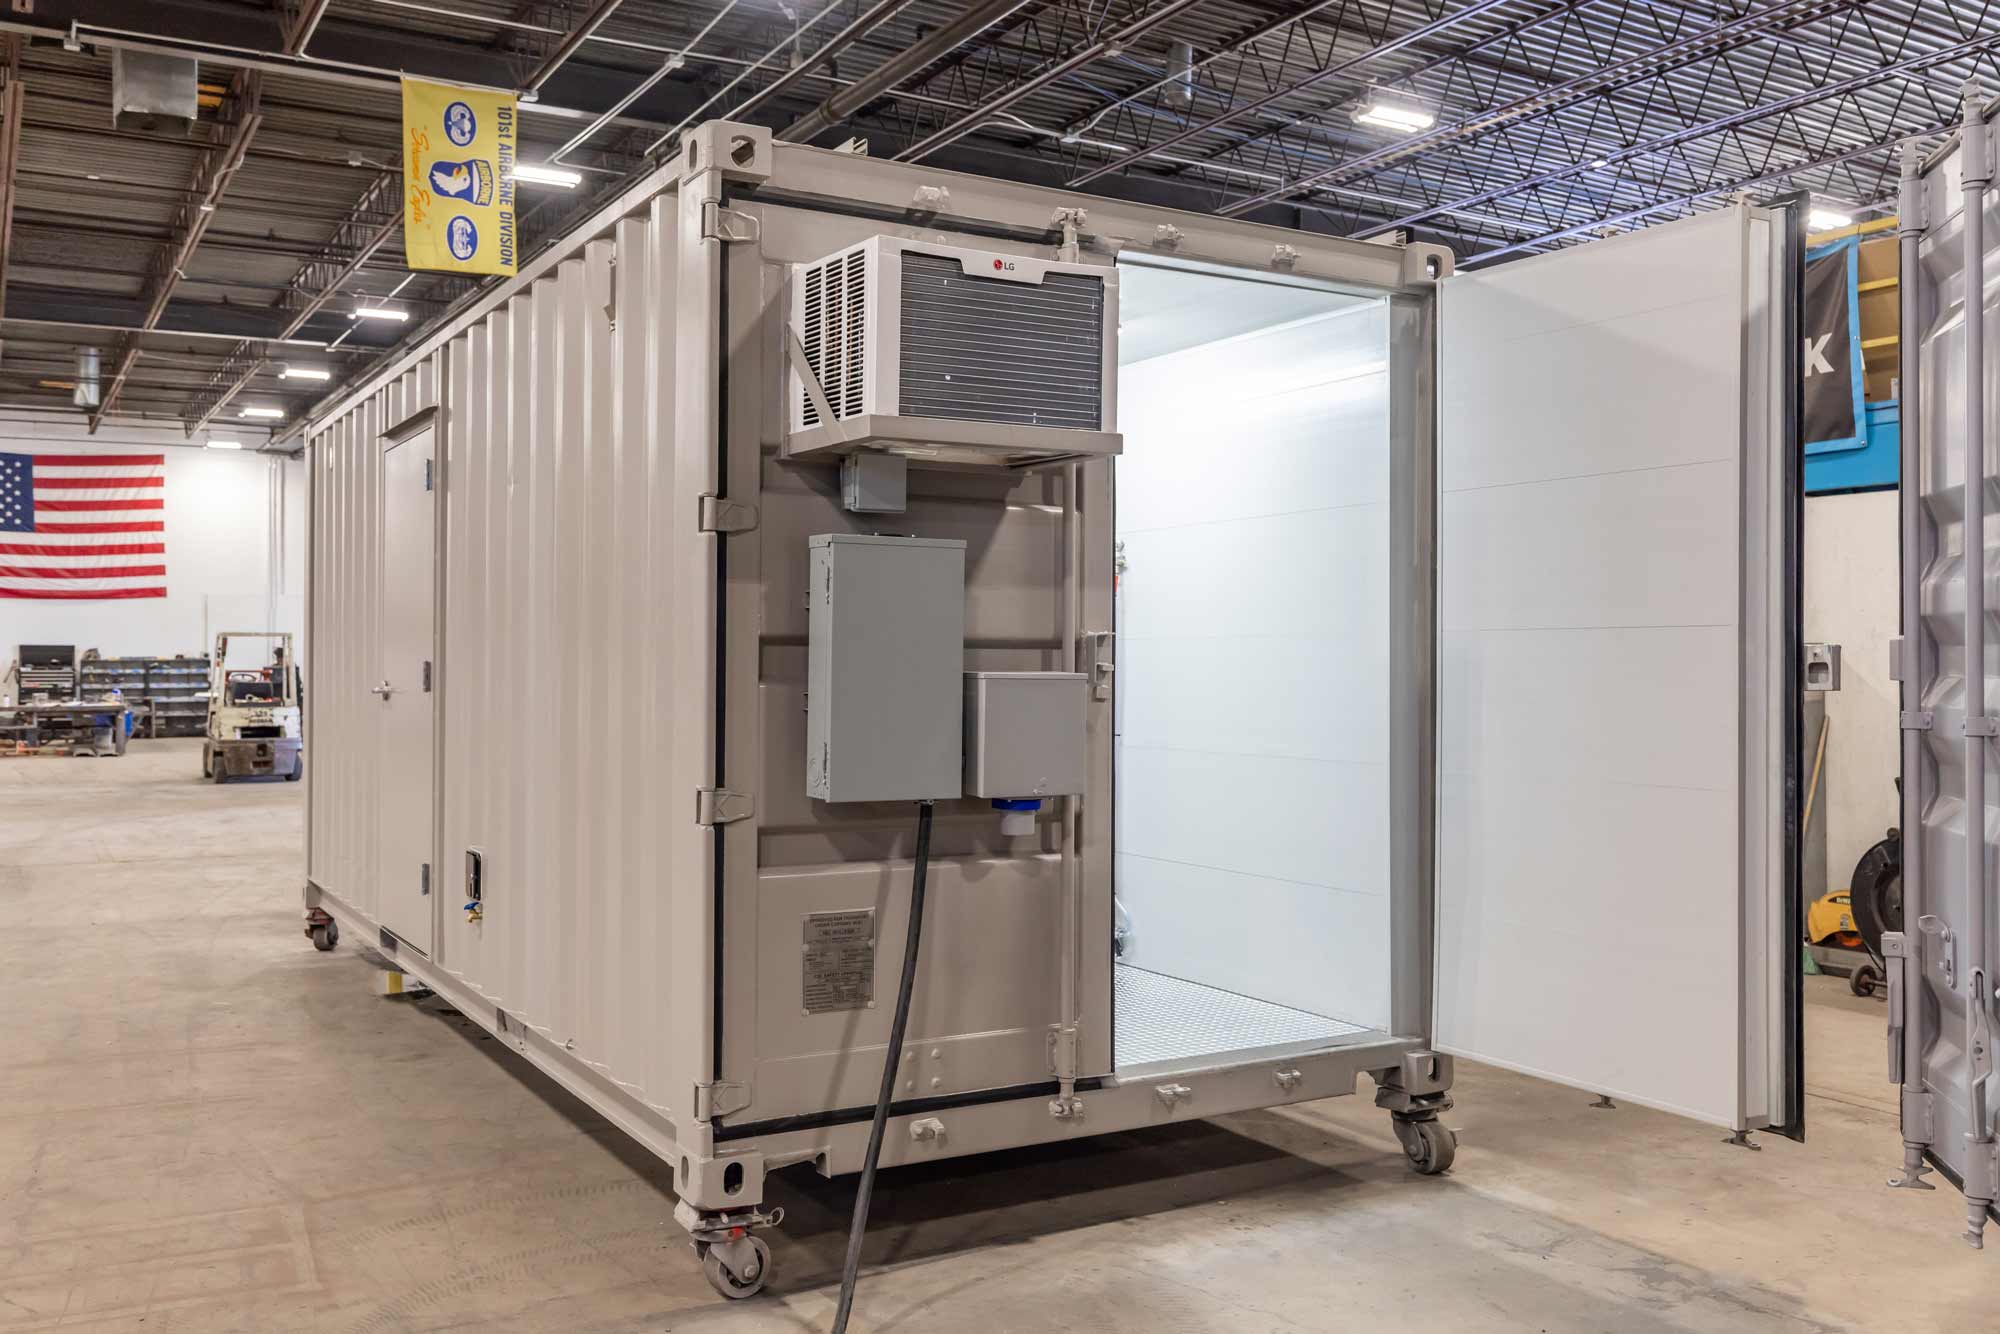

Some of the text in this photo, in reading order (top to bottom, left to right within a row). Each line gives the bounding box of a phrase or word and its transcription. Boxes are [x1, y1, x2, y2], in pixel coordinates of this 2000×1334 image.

[476, 161, 491, 205] AIRBORNE
[497, 106, 513, 266] 101st AIRBORNE DIVISION
[1003, 262, 1015, 271] LG
